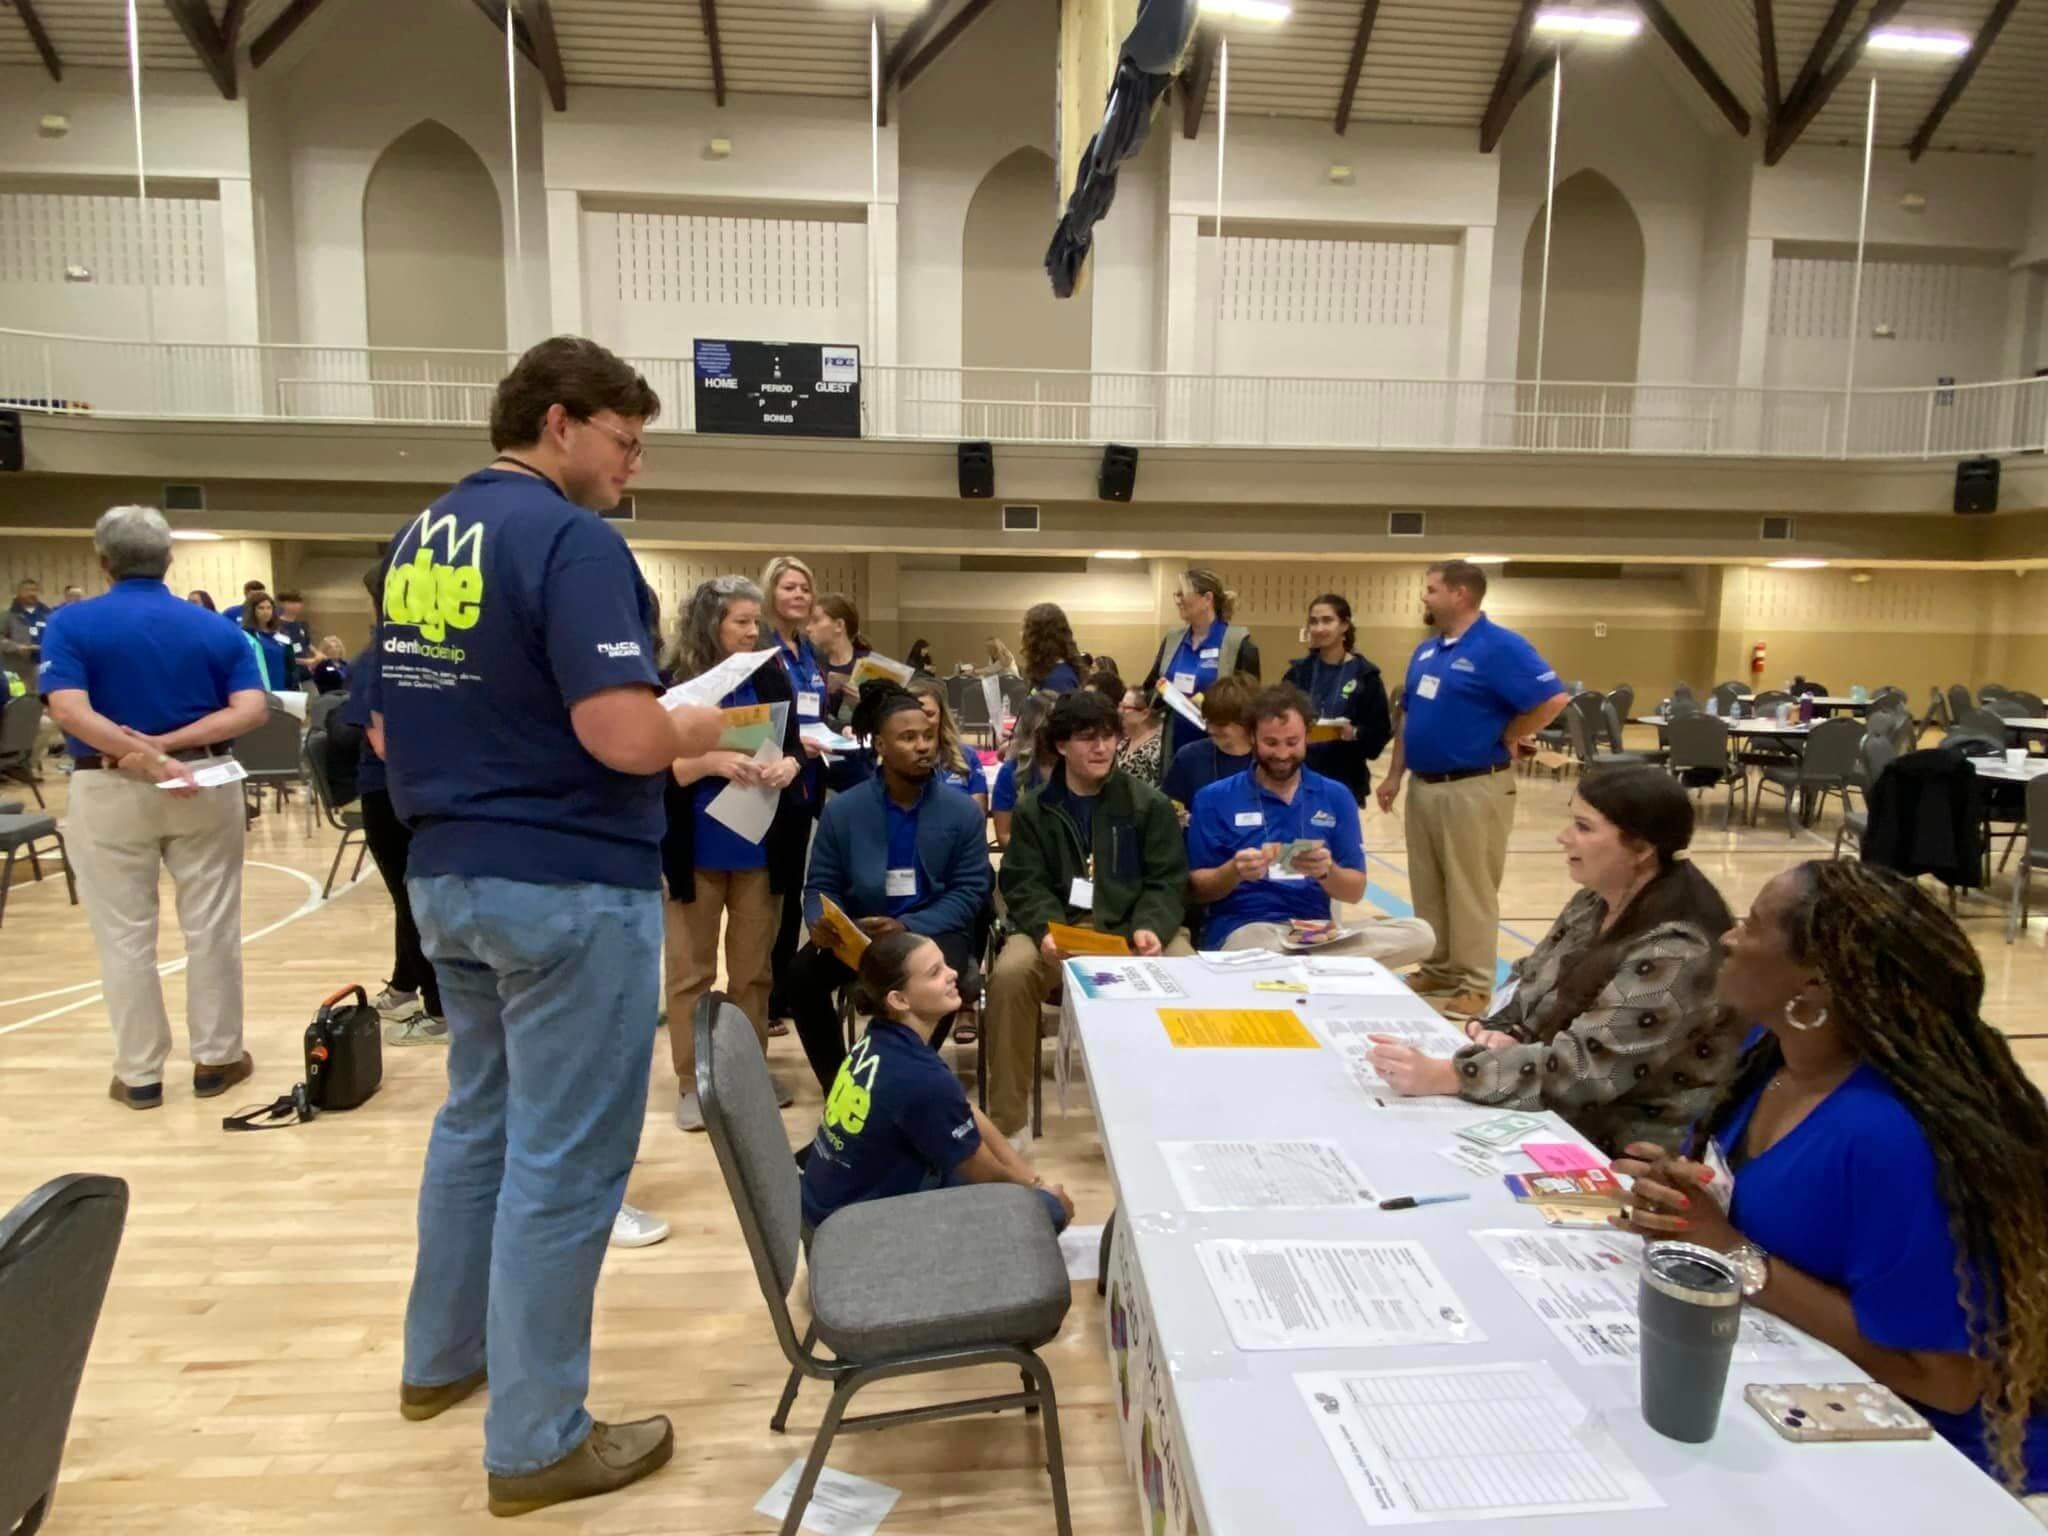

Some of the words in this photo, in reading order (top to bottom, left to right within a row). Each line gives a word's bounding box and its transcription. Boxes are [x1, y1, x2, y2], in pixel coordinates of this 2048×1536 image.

[705, 378, 738, 389] HOME
[761, 384, 794, 393] PERIOD
[815, 382, 852, 393] GUEST
[763, 414, 794, 423] BONUS
